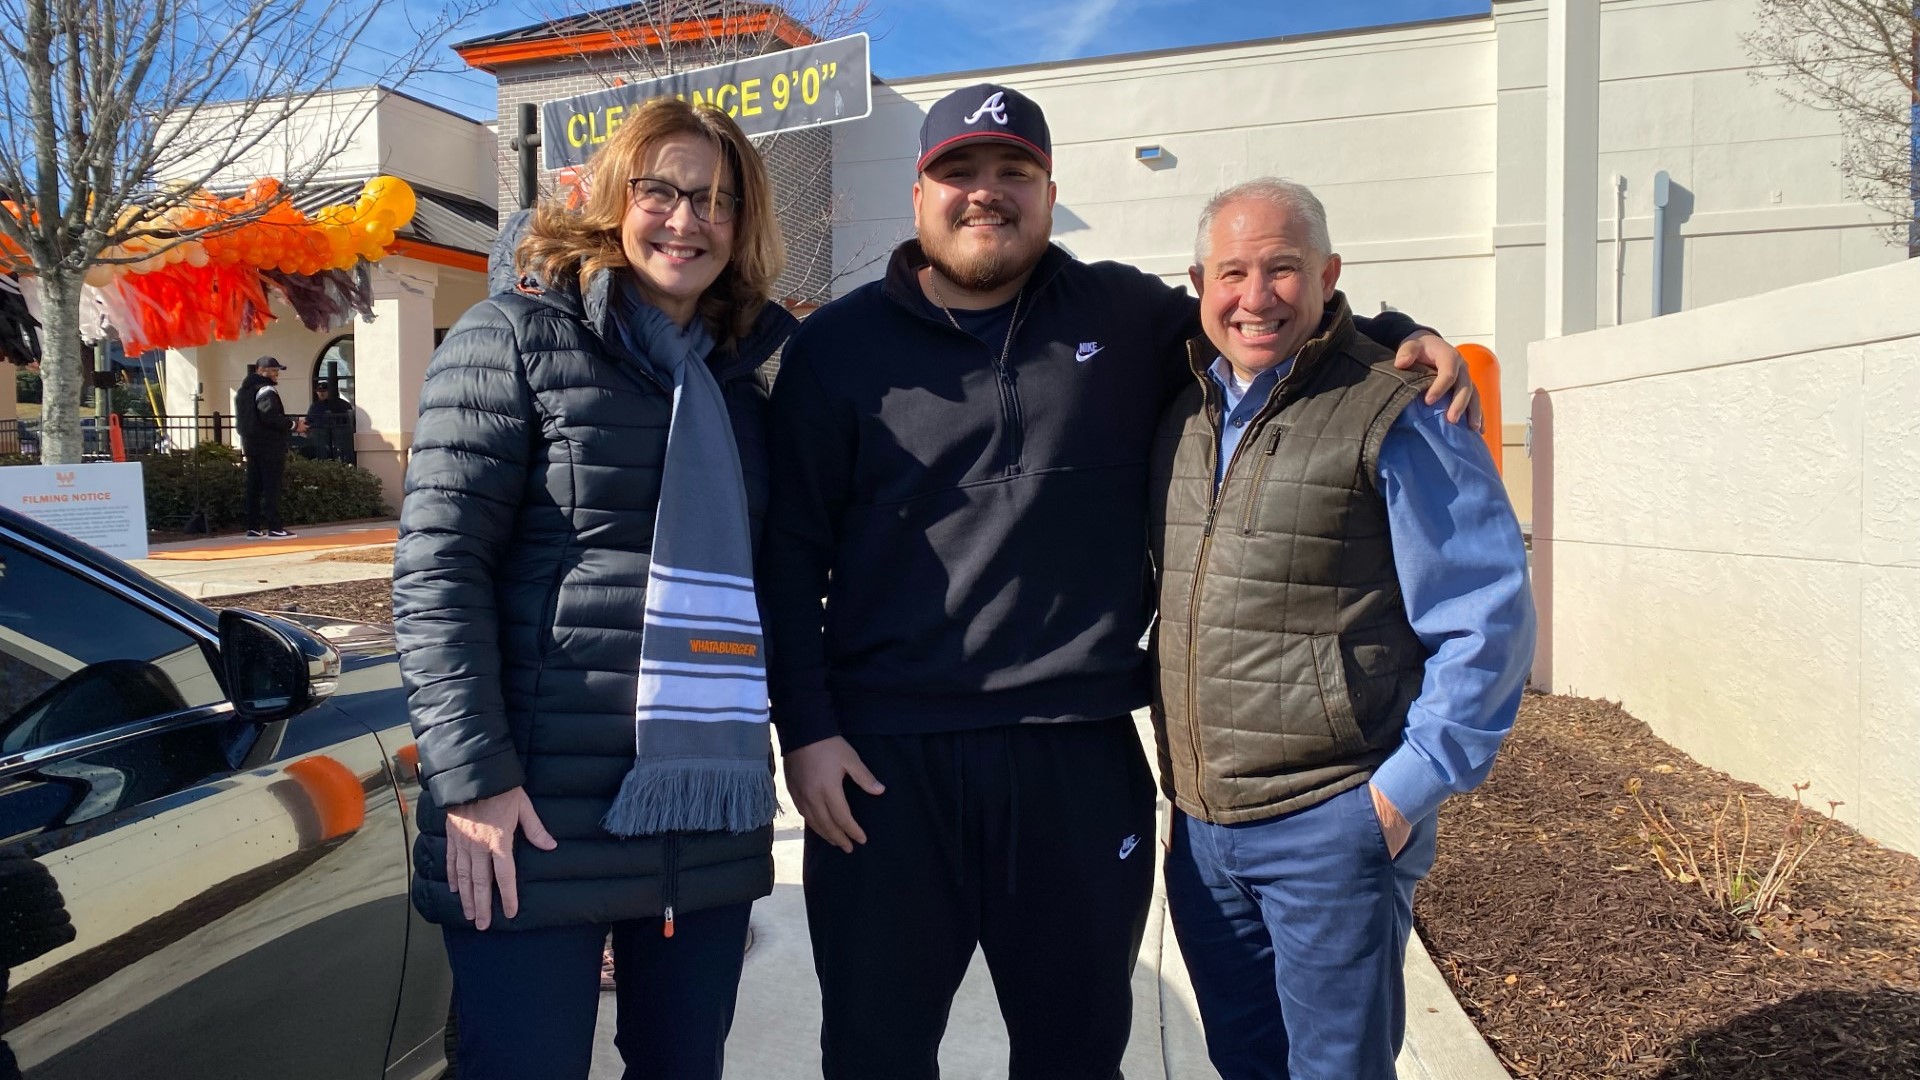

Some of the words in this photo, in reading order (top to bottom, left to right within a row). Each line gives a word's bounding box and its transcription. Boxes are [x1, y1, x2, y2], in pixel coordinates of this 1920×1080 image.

[567, 78, 762, 148] CLENCE
[964, 91, 1008, 125] A
[1079, 341, 1098, 353] NIKE
[22, 494, 69, 504] FILMING
[72, 492, 111, 502] NOTICE
[689, 639, 757, 657] WHATABURGER
